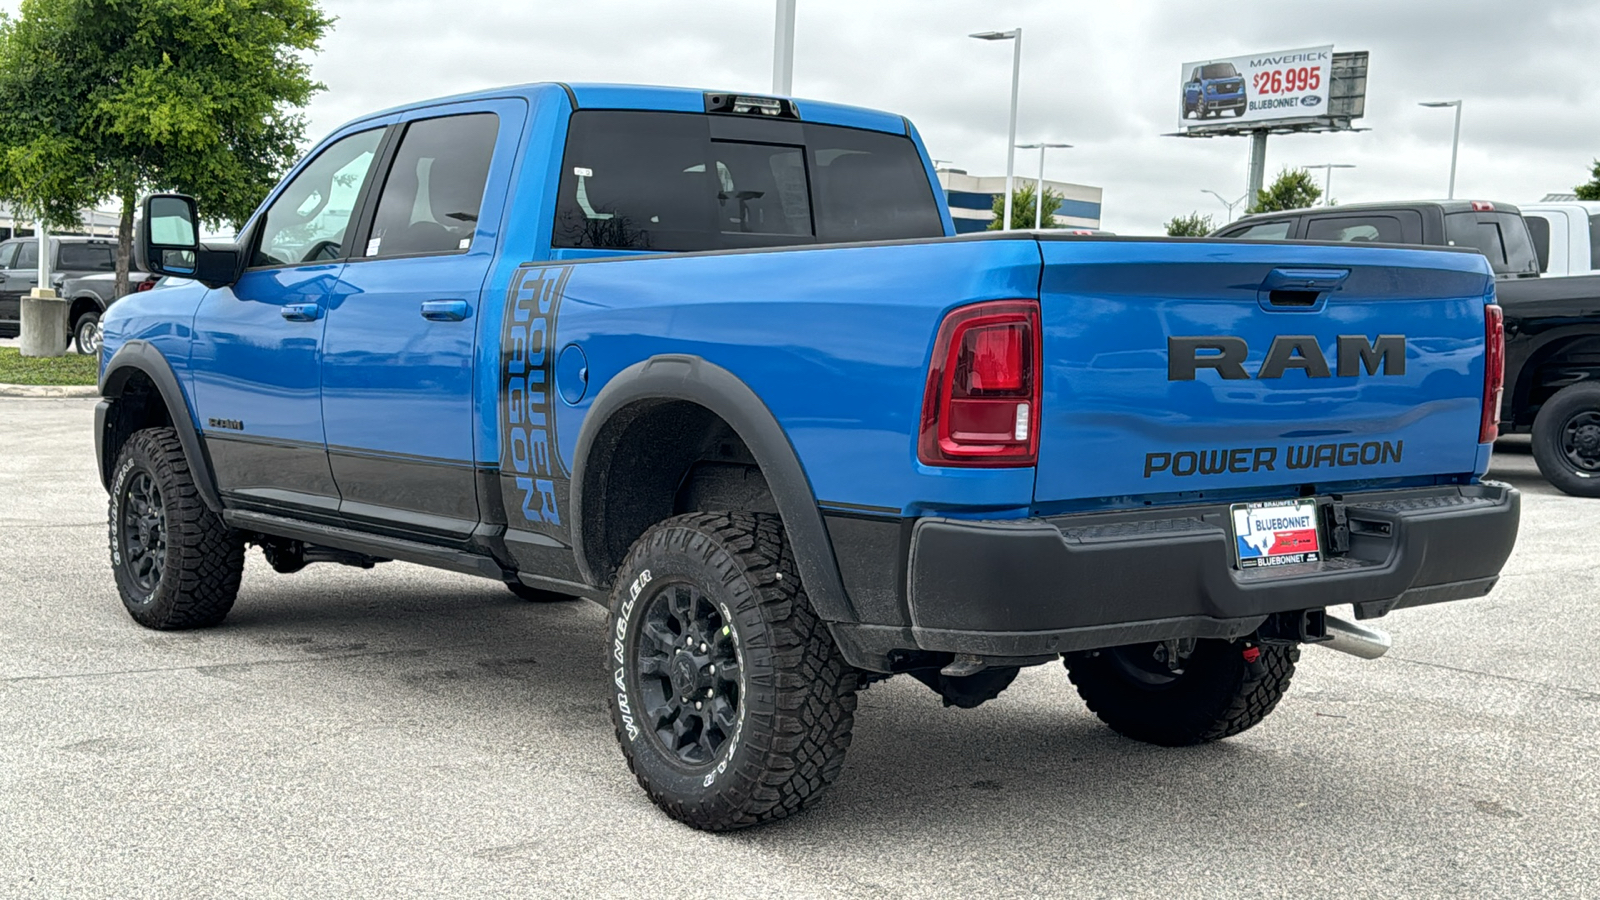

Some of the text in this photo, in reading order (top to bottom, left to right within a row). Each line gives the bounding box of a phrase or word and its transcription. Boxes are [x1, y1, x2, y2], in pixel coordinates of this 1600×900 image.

[1250, 51, 1328, 68] MAVERICK
[1253, 66, 1321, 95] $26,995
[1249, 97, 1300, 111] BLUEBONNET
[1167, 334, 1406, 381] RAM
[508, 268, 542, 522] WAGON
[527, 267, 564, 526] POWER
[1143, 440, 1404, 478] POWER WAGON
[1255, 516, 1310, 531] BLUEBONNET
[1257, 554, 1304, 566] BLUEBONNET
[614, 569, 653, 742] WRANGLER
